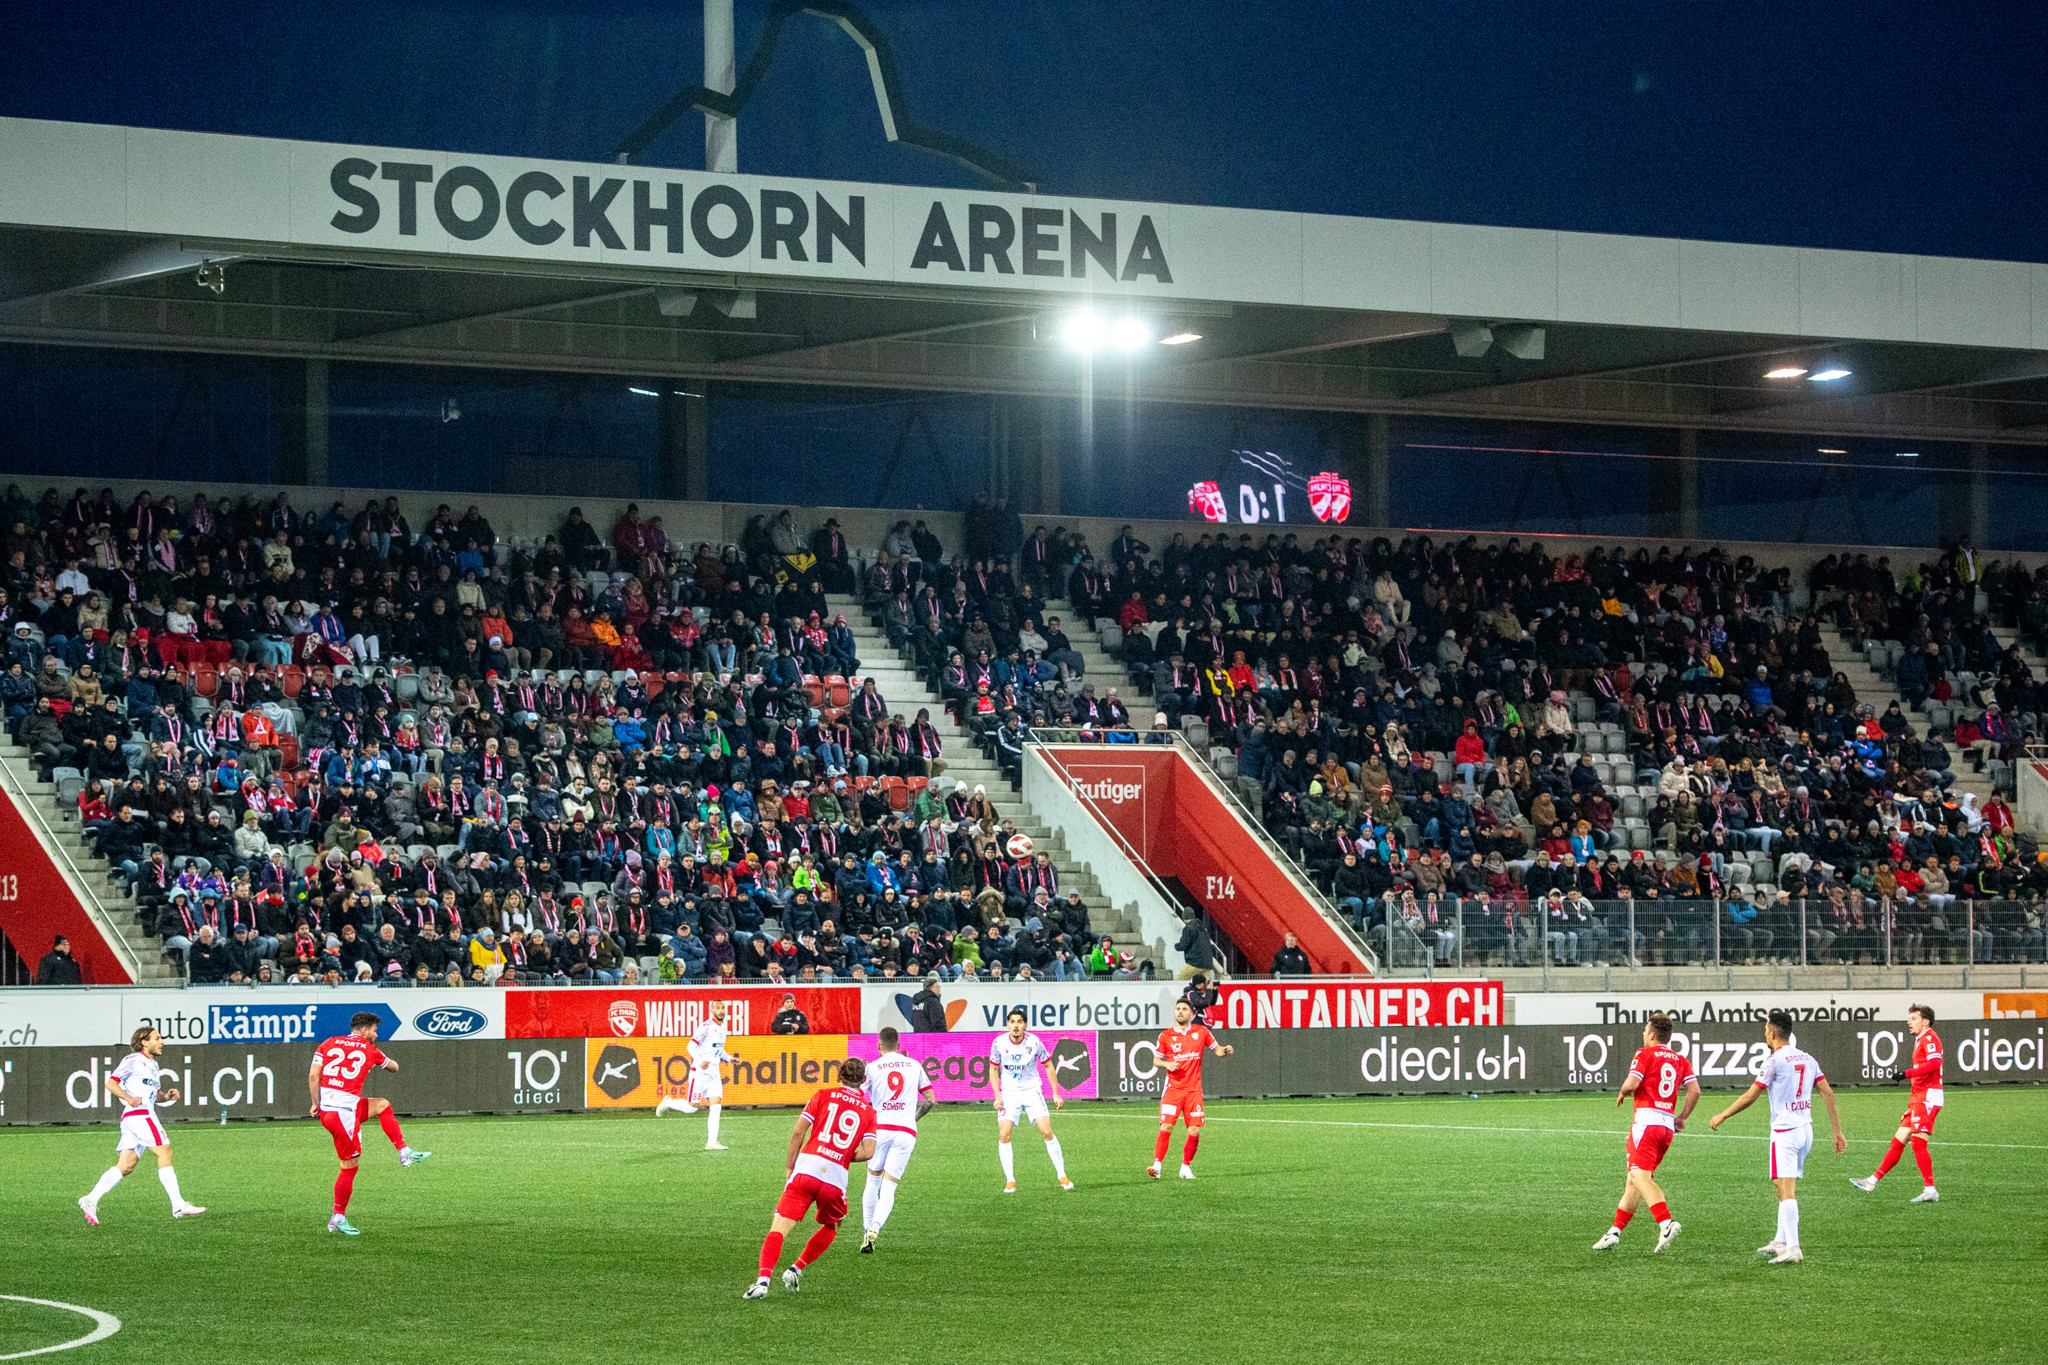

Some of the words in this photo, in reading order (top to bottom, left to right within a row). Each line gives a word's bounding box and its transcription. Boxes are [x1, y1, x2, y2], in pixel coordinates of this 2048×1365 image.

[330, 157, 865, 268] STOCKHORN
[910, 201, 1174, 284] ARENA
[1071, 777, 1142, 804] Frutiger
[0, 874, 17, 901] 13
[1206, 876, 1235, 900] F14
[210, 1006, 317, 1042] kämpf
[428, 1010, 473, 1033] Ford
[619, 1009, 636, 1017] THUN
[1076, 996, 1160, 1026] beton
[1700, 1000, 1880, 1022] Amtsnzeiger
[0, 1023, 38, 1046] .ch
[1957, 1027, 2044, 1072] dieci
[323, 1047, 366, 1080] 23
[1113, 1041, 1158, 1079] 10
[1667, 1032, 1797, 1076] Pizza
[65, 1054, 274, 1109] dici.ch
[652, 1055, 693, 1085] 10
[1120, 1078, 1160, 1092] dieci
[1568, 1069, 1608, 1084] dieci
[1658, 1062, 1677, 1099] 8
[1794, 1064, 1806, 1100] 7
[513, 1088, 560, 1104] dieci
[656, 1085, 686, 1098] diec
[887, 1070, 904, 1101] 9
[817, 1102, 861, 1150] 19
[816, 1145, 844, 1161] BAMERT
